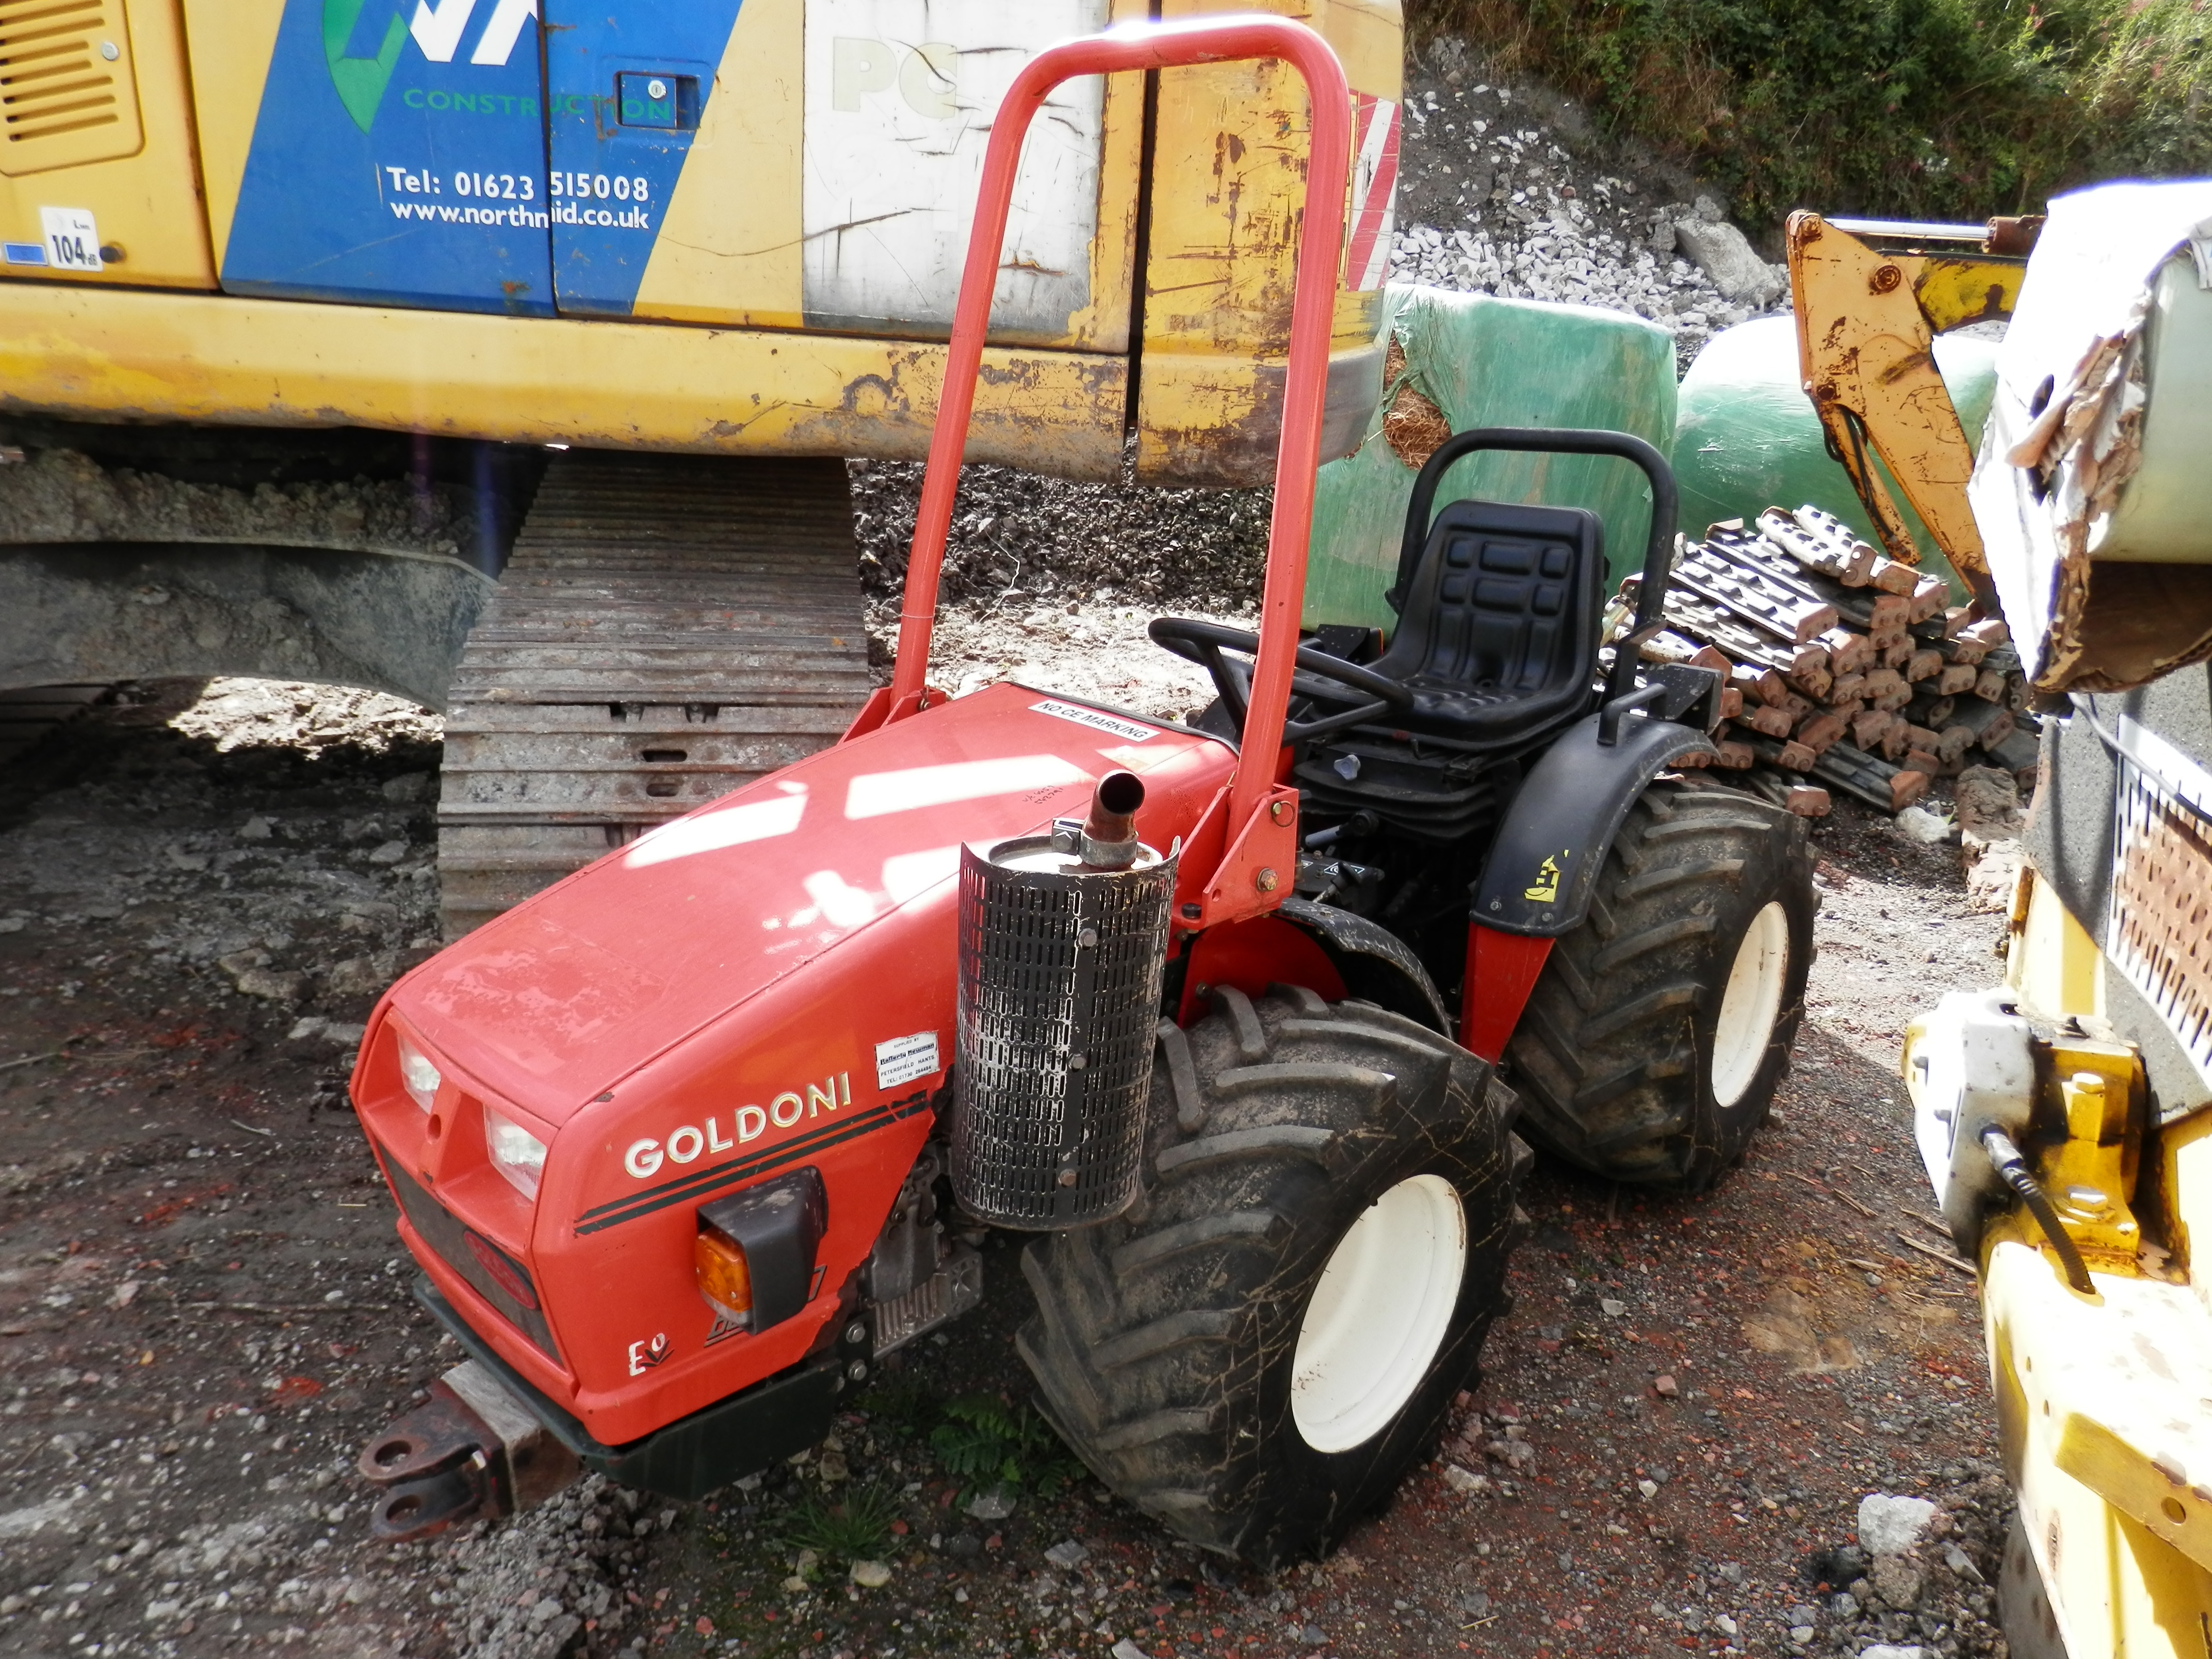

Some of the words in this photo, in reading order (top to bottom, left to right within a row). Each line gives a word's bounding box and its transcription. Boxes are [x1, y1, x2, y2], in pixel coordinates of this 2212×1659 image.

[402, 89, 670, 121] CONSTRUCTION
[385, 166, 441, 194] Tel:
[454, 171, 534, 201] 01623
[550, 171, 649, 202] 515008
[390, 201, 649, 230] www.northmid.co.uk
[52, 235, 87, 265] 104
[1038, 703, 1062, 712] NO
[1061, 709, 1084, 718] CE
[1081, 715, 1148, 738] MARKING
[894, 1039, 912, 1049] SUPPLIED
[907, 1043, 934, 1056] Newman
[881, 1062, 914, 1077] PETERSFIELD
[899, 1071, 913, 1080] 01730
[624, 1071, 851, 1179] GOLDONI
